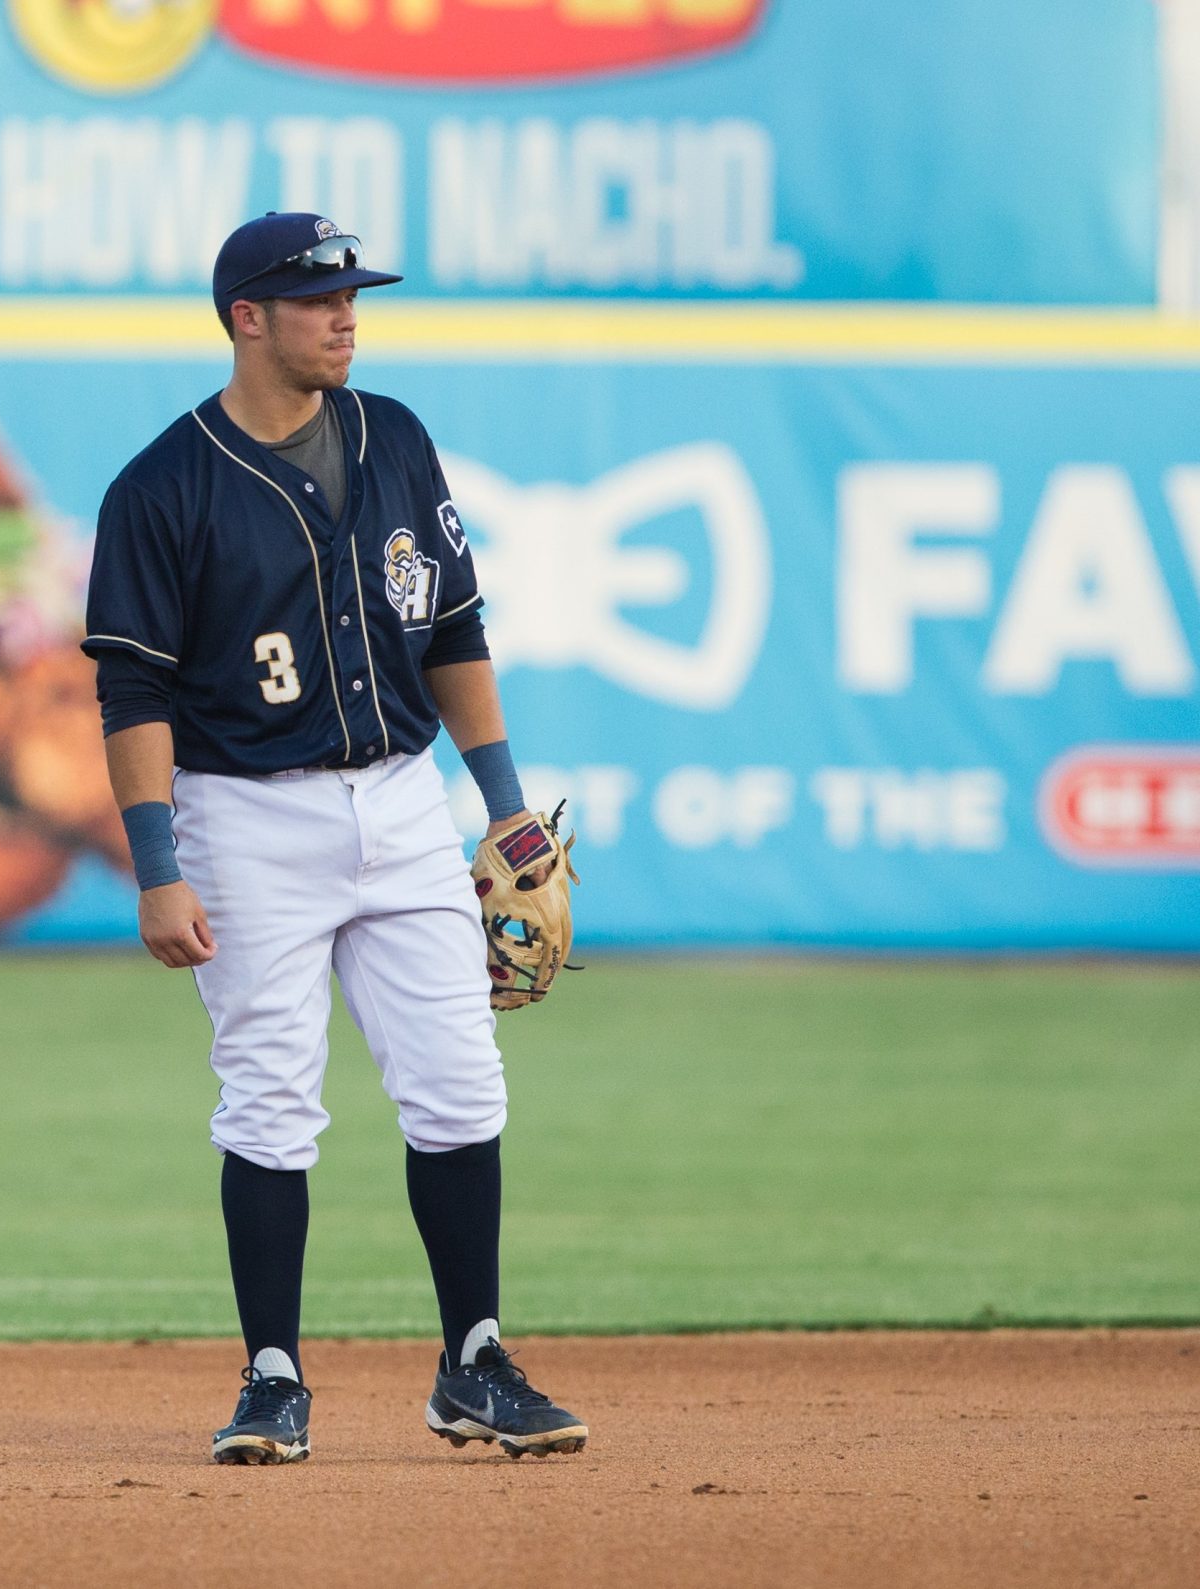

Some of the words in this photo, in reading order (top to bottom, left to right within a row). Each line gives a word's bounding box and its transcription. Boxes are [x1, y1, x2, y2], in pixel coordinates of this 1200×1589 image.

[267, 116, 403, 284] TO
[835, 461, 1200, 695] FA
[254, 632, 302, 705] 3
[653, 766, 792, 850] OF
[814, 766, 1003, 852] THE
